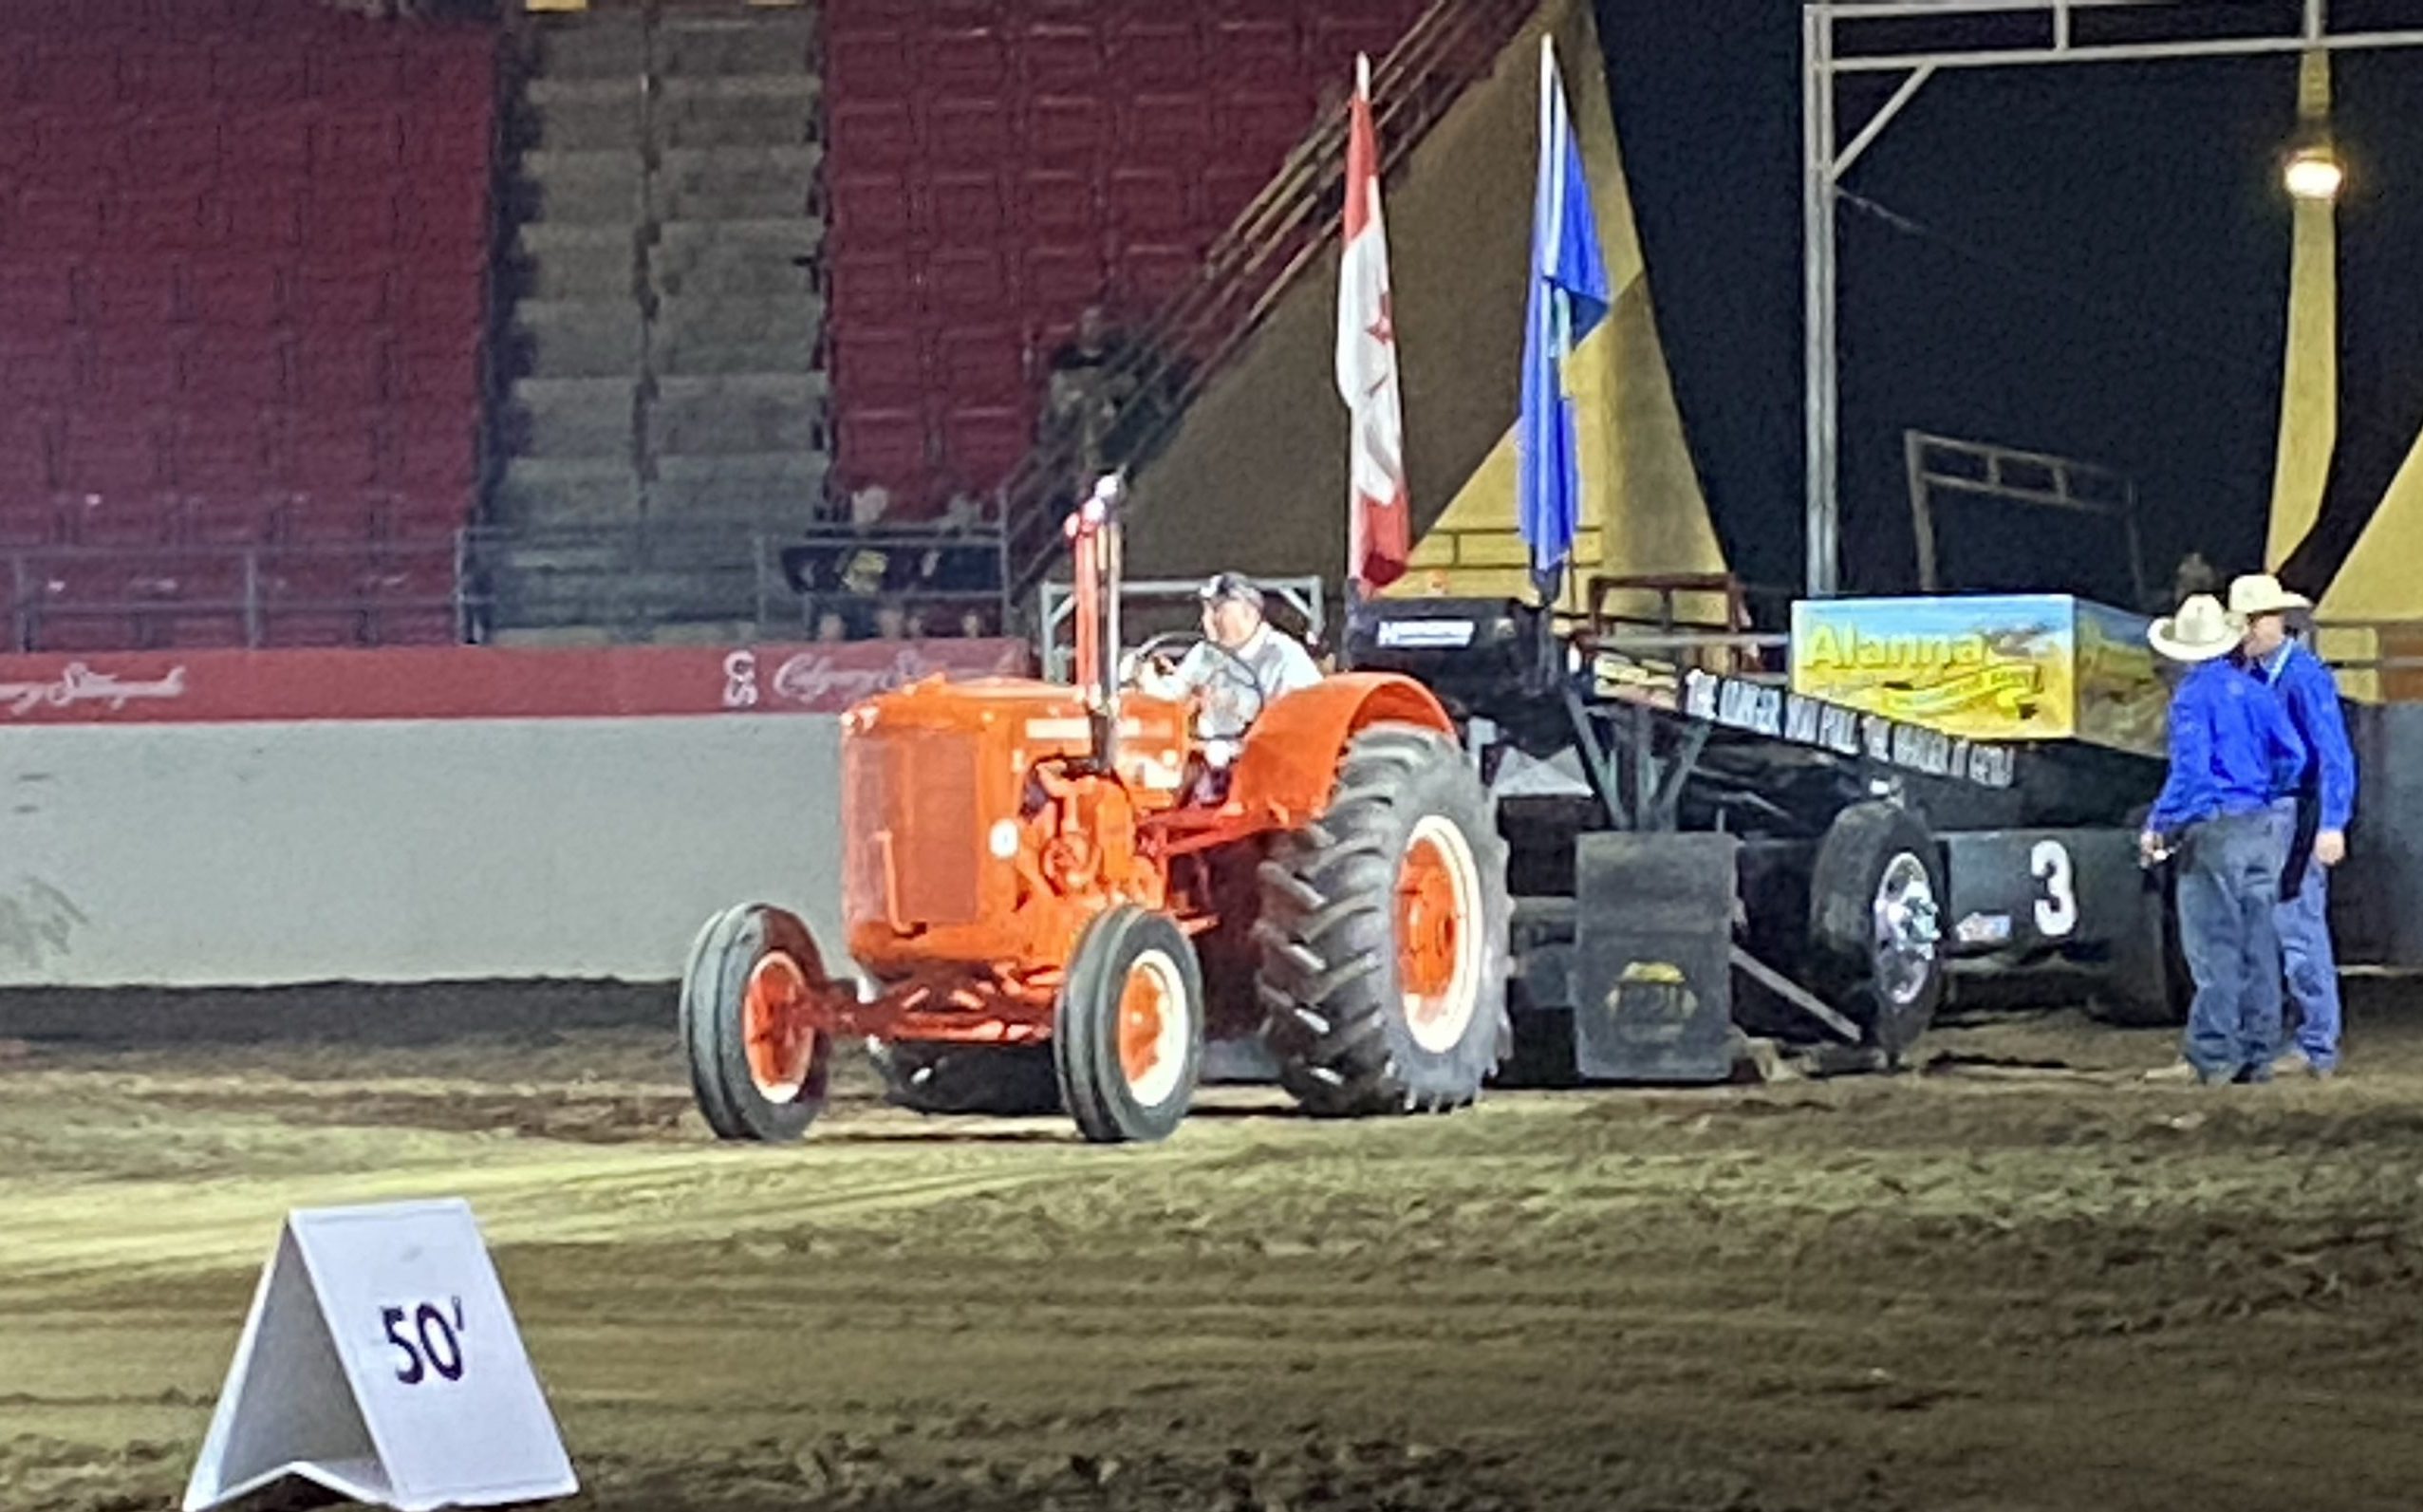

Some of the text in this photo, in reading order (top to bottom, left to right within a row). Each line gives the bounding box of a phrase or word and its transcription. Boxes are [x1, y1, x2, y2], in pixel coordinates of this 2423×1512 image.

[1805, 622, 1988, 669] Alanna
[2031, 840, 2078, 935] 3
[381, 1296, 463, 1385] 50'
